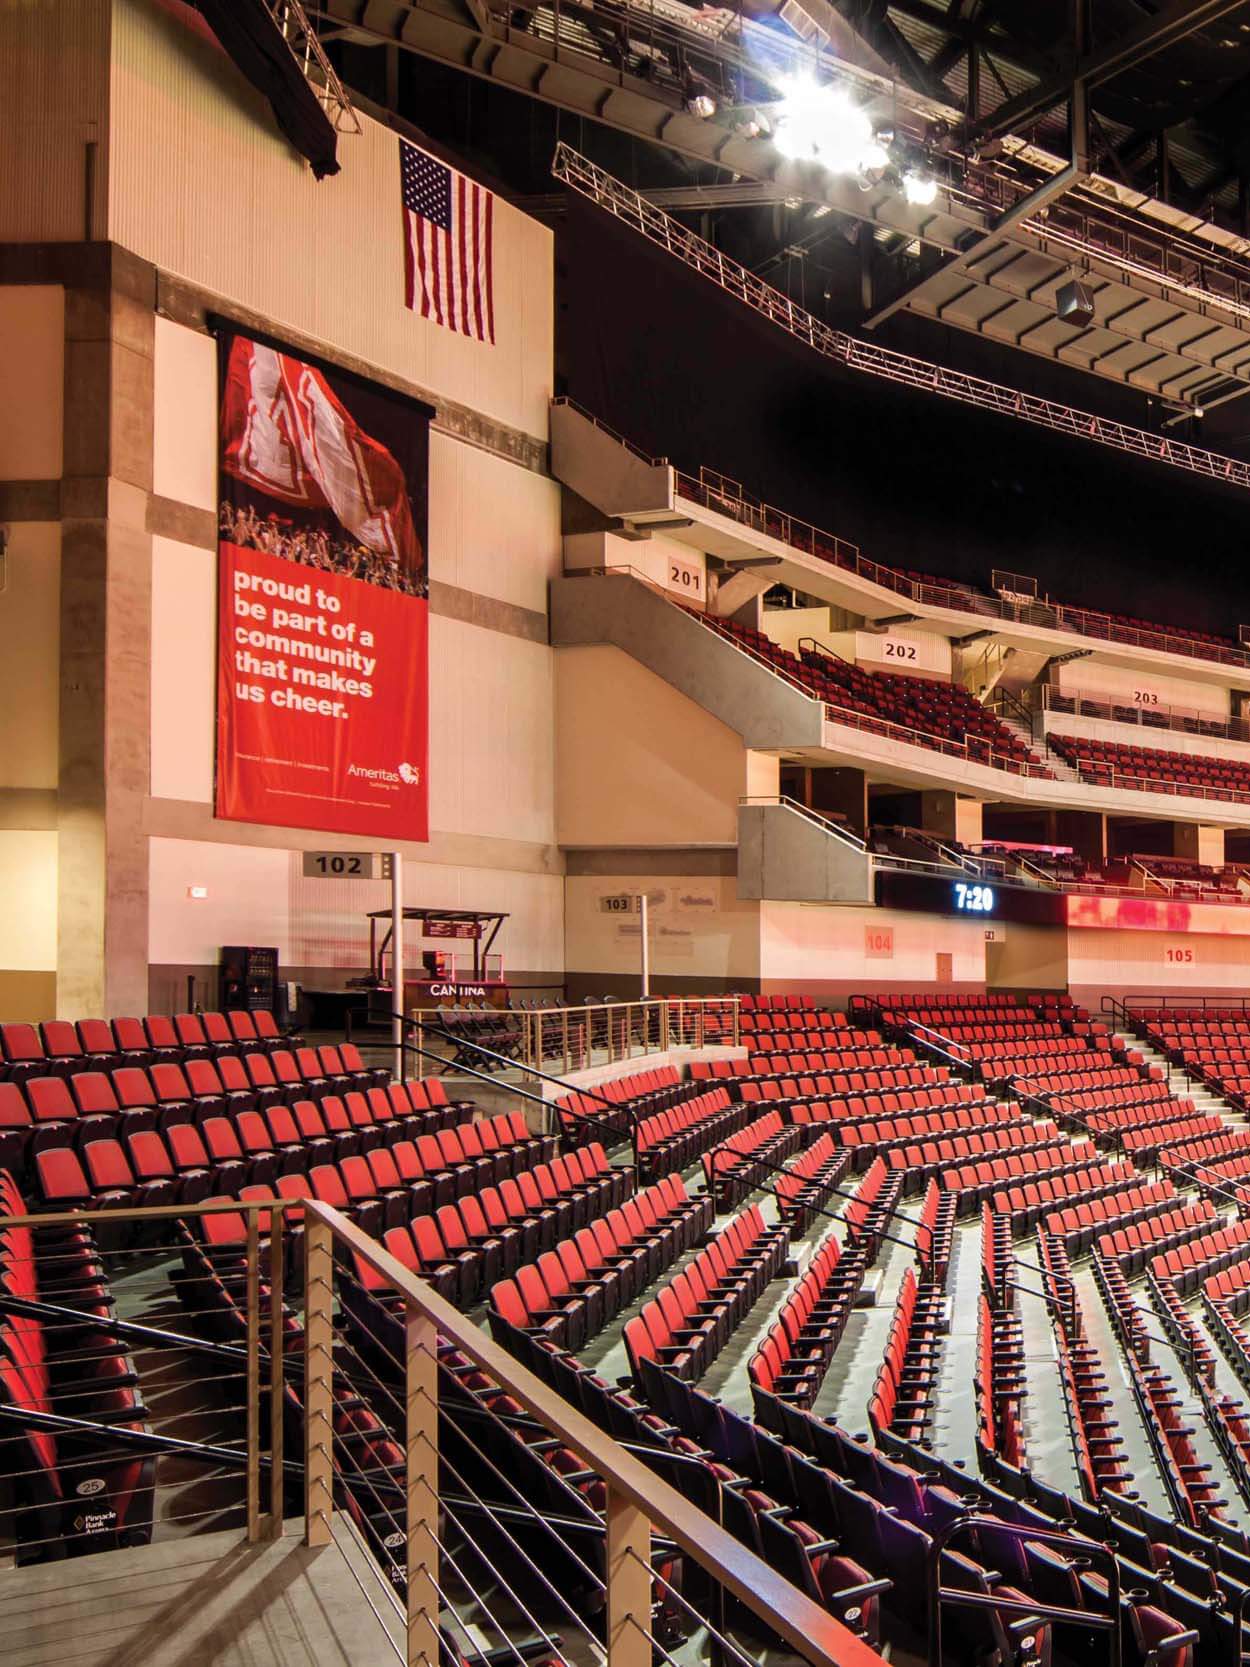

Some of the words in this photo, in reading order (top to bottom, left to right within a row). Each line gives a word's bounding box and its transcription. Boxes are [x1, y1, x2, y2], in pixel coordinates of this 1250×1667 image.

[671, 566, 699, 590] 201
[234, 570, 311, 606] proud
[315, 588, 341, 613] to
[234, 593, 267, 621] be
[271, 607, 327, 636] part
[331, 622, 356, 642] of
[359, 629, 374, 648] a
[234, 626, 377, 676] community
[885, 643, 917, 660] 202
[234, 650, 288, 681] that
[292, 666, 374, 698] makes
[235, 682, 265, 703] us
[270, 687, 349, 719] cheer.
[1133, 690, 1159, 706] 203
[347, 763, 400, 783] Ameritas
[315, 856, 361, 875] 102
[605, 898, 629, 911] 103
[955, 883, 994, 912] 7:20
[867, 935, 891, 951] 104
[1167, 949, 1193, 962] 105
[82, 1481, 99, 1493] 25
